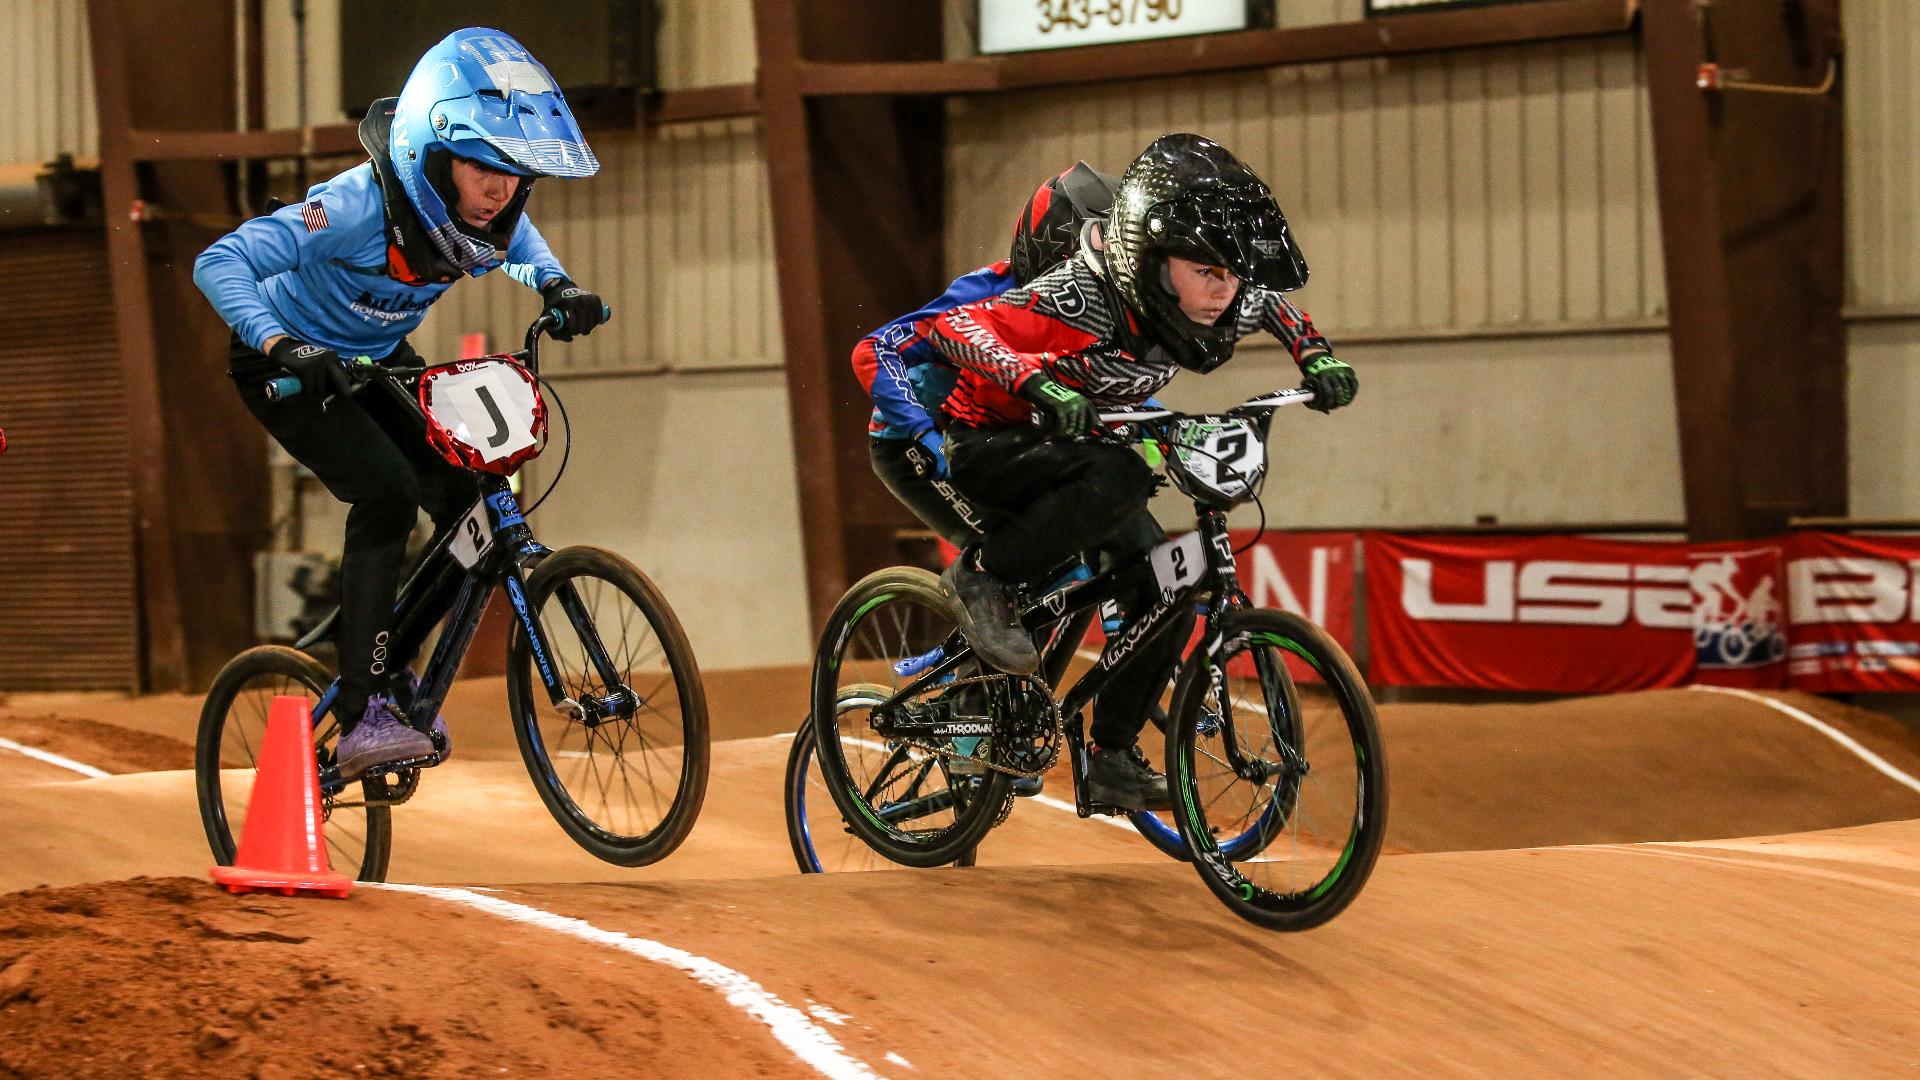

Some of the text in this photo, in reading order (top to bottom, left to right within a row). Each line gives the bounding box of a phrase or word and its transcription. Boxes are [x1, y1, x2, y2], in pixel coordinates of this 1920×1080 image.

[349, 301, 408, 321] HOUSTON
[475, 385, 510, 448] J
[1216, 433, 1248, 485] 2
[466, 516, 485, 553] 2
[1170, 546, 1188, 581] 2
[1788, 557, 1920, 624] B
[522, 613, 555, 687] ANSWER
